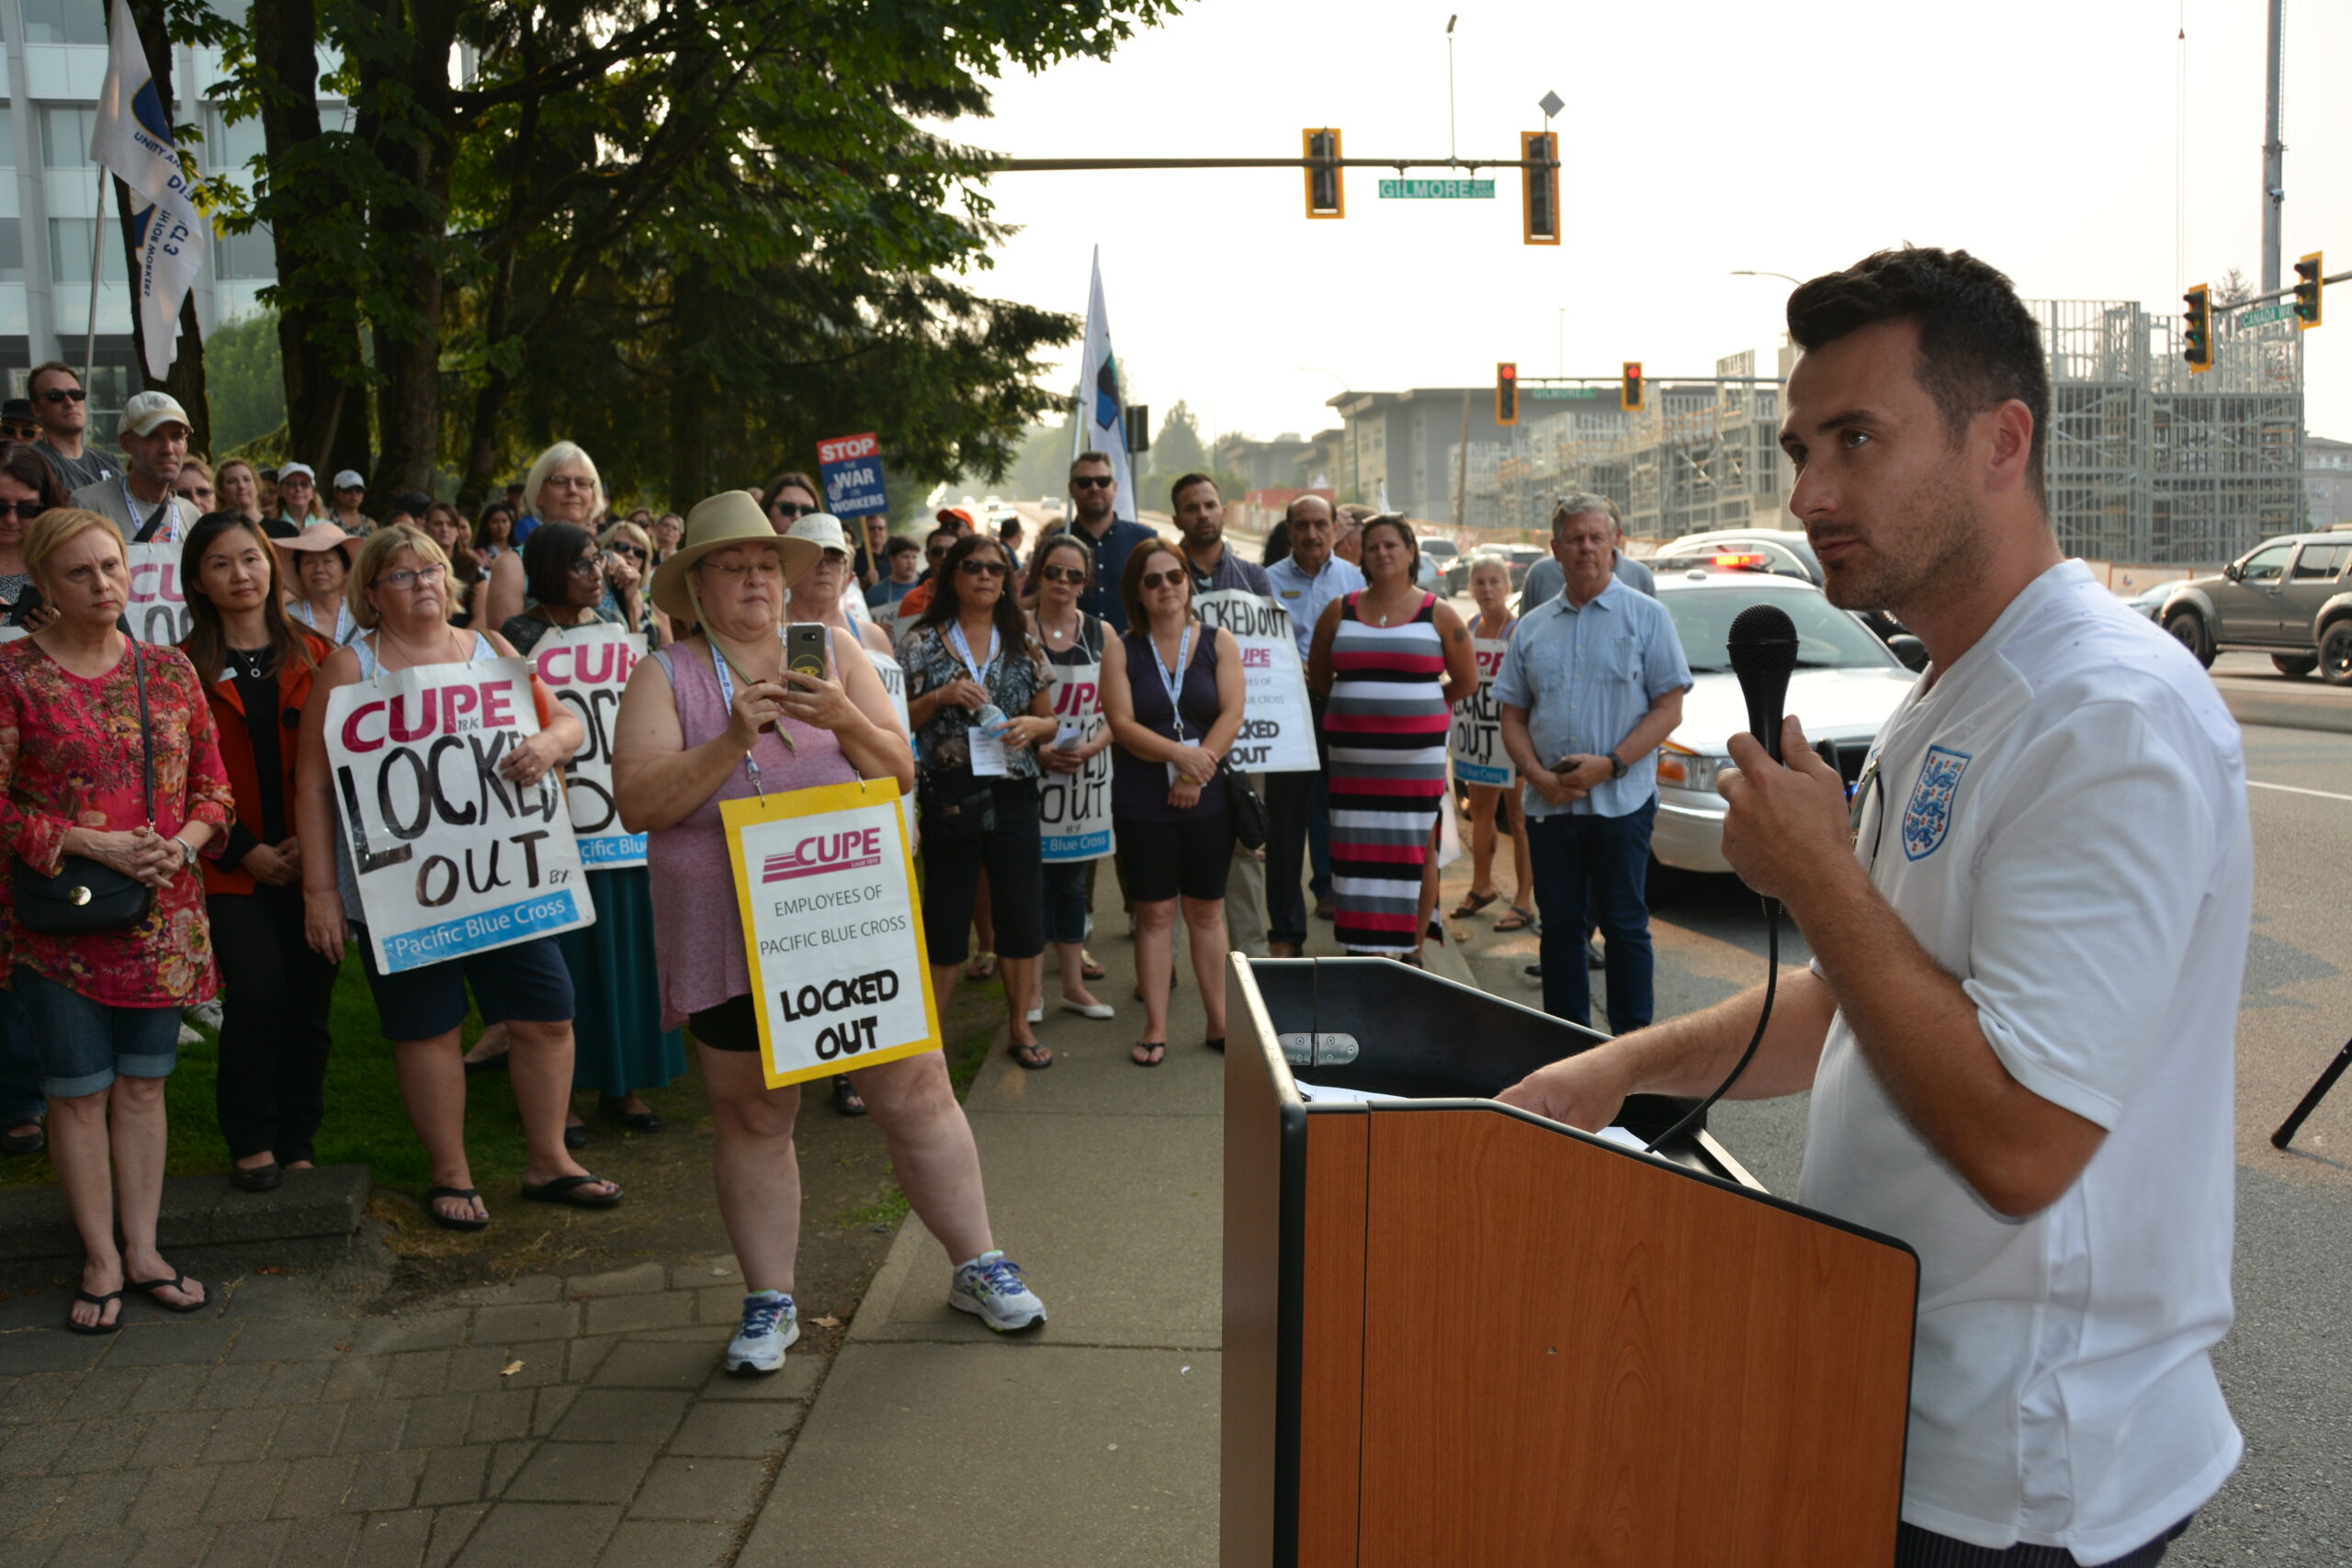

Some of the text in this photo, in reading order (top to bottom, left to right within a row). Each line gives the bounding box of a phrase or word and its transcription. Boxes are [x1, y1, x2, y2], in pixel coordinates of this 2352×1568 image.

[133, 131, 181, 172] UNITY AN
[1380, 180, 1470, 197] GILMORE
[2243, 308, 2276, 327] CANADA
[820, 437, 876, 462] STOP
[844, 460, 856, 469] THE
[832, 468, 876, 490] WAR
[829, 493, 886, 514] WORKERS
[849, 489, 861, 497] ON
[127, 563, 185, 604] CU
[1258, 608, 1289, 638] OUT
[1258, 694, 1285, 705] CROSS
[341, 679, 517, 754] CUPE
[1458, 721, 1498, 757] OUT
[1229, 746, 1272, 765] OUT
[1481, 769, 1502, 781] Cross
[1039, 781, 1107, 824] OUT
[1050, 838, 1079, 852] Blue
[1080, 834, 1106, 850] Cross
[1067, 824, 1082, 835] BY
[581, 840, 616, 858] cific
[795, 827, 881, 867] CUPE
[415, 829, 550, 908] OUT
[775, 884, 883, 918] EMPLOYEES OF
[395, 899, 566, 957] Pacific Blue Cross
[760, 915, 907, 956] PACIFIC BLUE CROSS
[780, 968, 899, 1023] LOCKED
[815, 1015, 877, 1061] OUT
